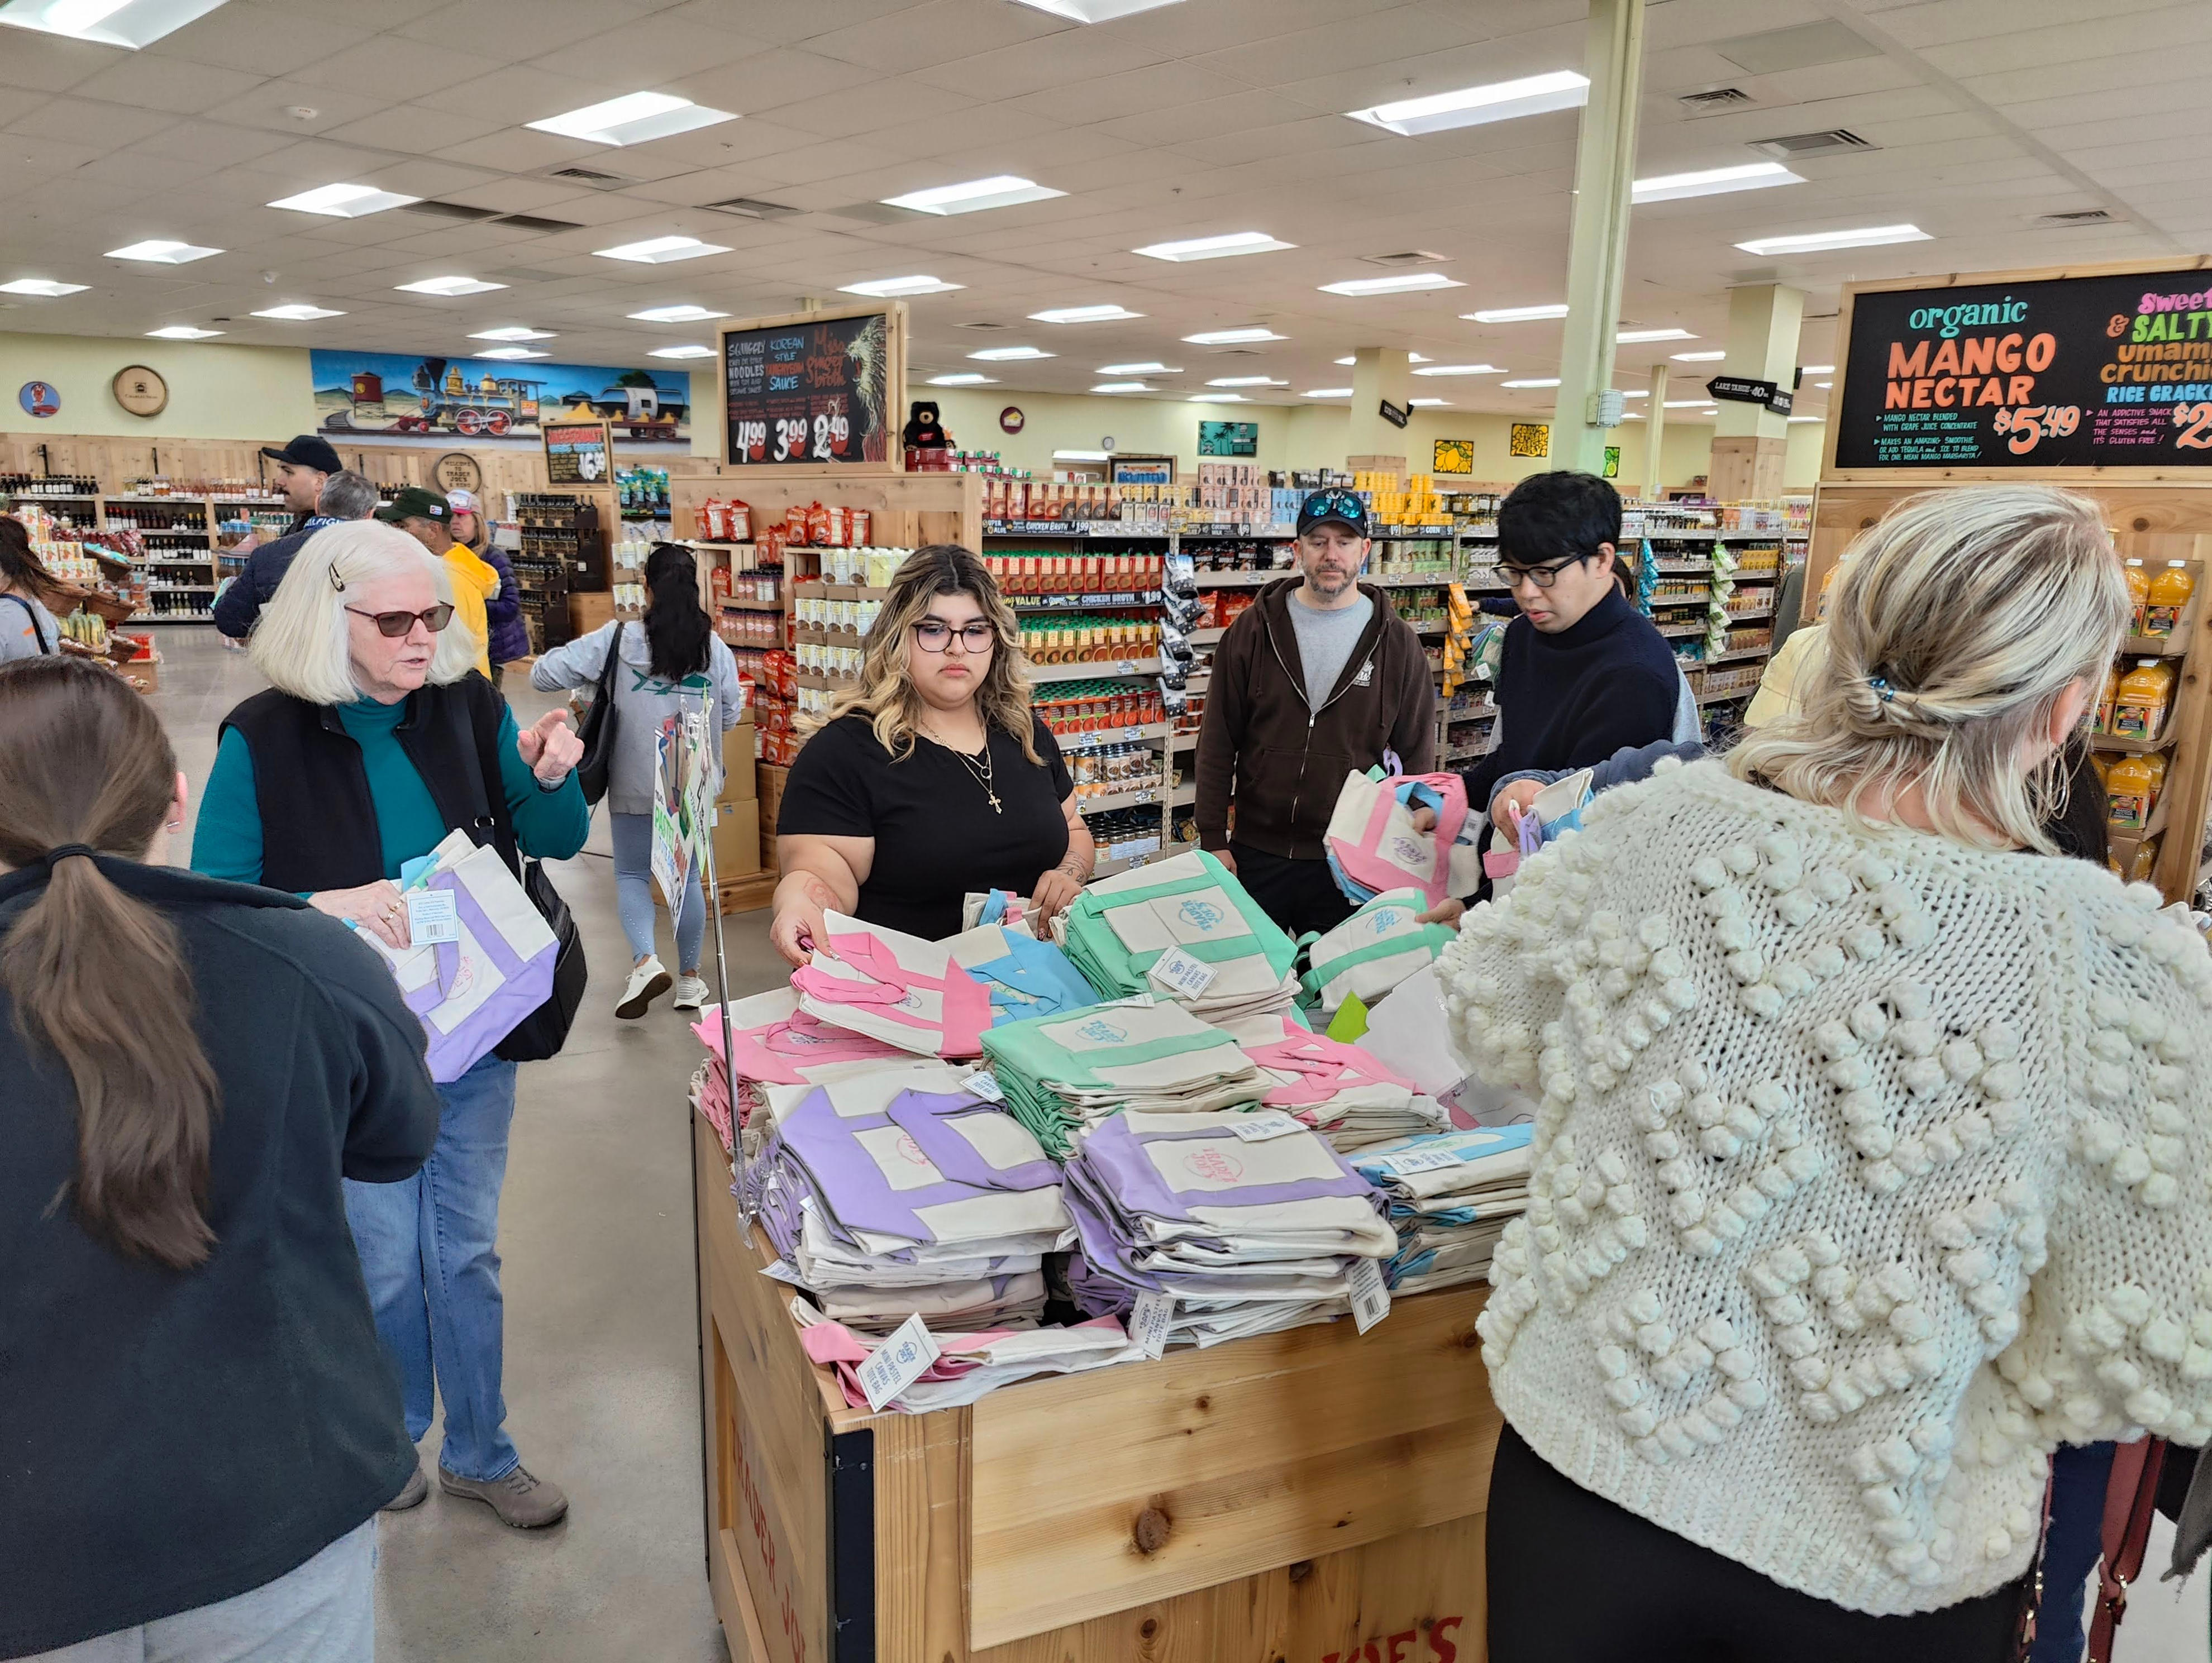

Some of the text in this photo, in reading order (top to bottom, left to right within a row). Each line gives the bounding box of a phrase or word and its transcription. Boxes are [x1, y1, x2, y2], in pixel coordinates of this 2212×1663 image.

[1909, 296, 2028, 338] organic
[2106, 314, 2130, 337] &
[769, 336, 804, 351] KOREAN
[774, 352, 797, 362] STYLE
[1887, 333, 2056, 379] MANGO
[728, 364, 764, 379] NOODLES
[769, 376, 799, 391] SAUCE
[1885, 375, 2035, 409] NECTAR
[2106, 386, 2146, 403] RICE
[1884, 413, 1958, 422] MANGO NECTAR BLENDED
[1993, 405, 2080, 455] $5.49
[1016, 596, 1041, 606] VALUE
[1081, 595, 1110, 603] CHICKEN
[1112, 594, 1134, 602] BROTH
[1177, 963, 1199, 986] MINI PASTEL
[1186, 970, 1201, 986] CANVAS
[1191, 973, 1208, 990] TOTE BAG
[1151, 1299, 1161, 1325] PASTEL
[1152, 1309, 1163, 1339] CANVAS
[875, 1361, 890, 1385] CANVAS
[880, 1349, 902, 1384] MINI PASTEL
[867, 1367, 883, 1394] TOTE BAG
[731, 1415, 776, 1596] TRADER
